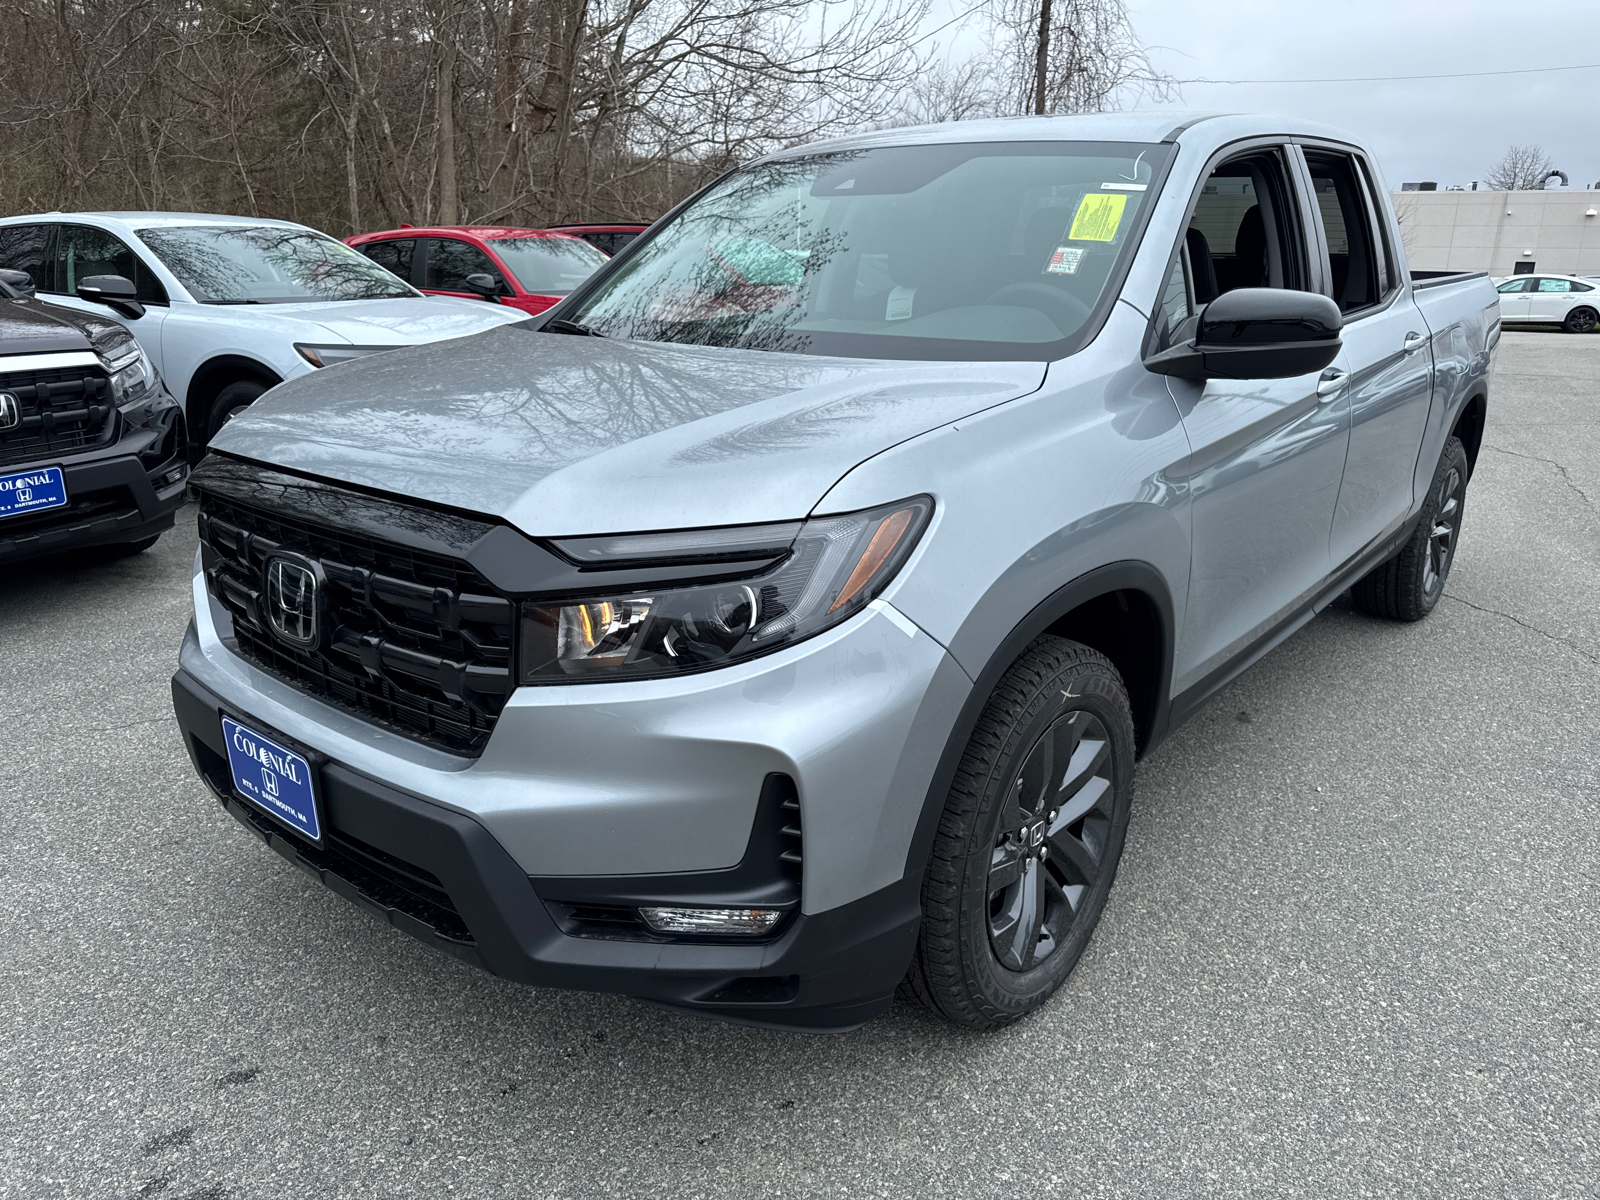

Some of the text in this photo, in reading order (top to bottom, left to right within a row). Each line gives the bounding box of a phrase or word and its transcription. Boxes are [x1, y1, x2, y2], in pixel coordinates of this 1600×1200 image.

[0, 474, 54, 492] OLONIAL
[233, 733, 301, 785] COLONIAL
[298, 812, 307, 823] MA
